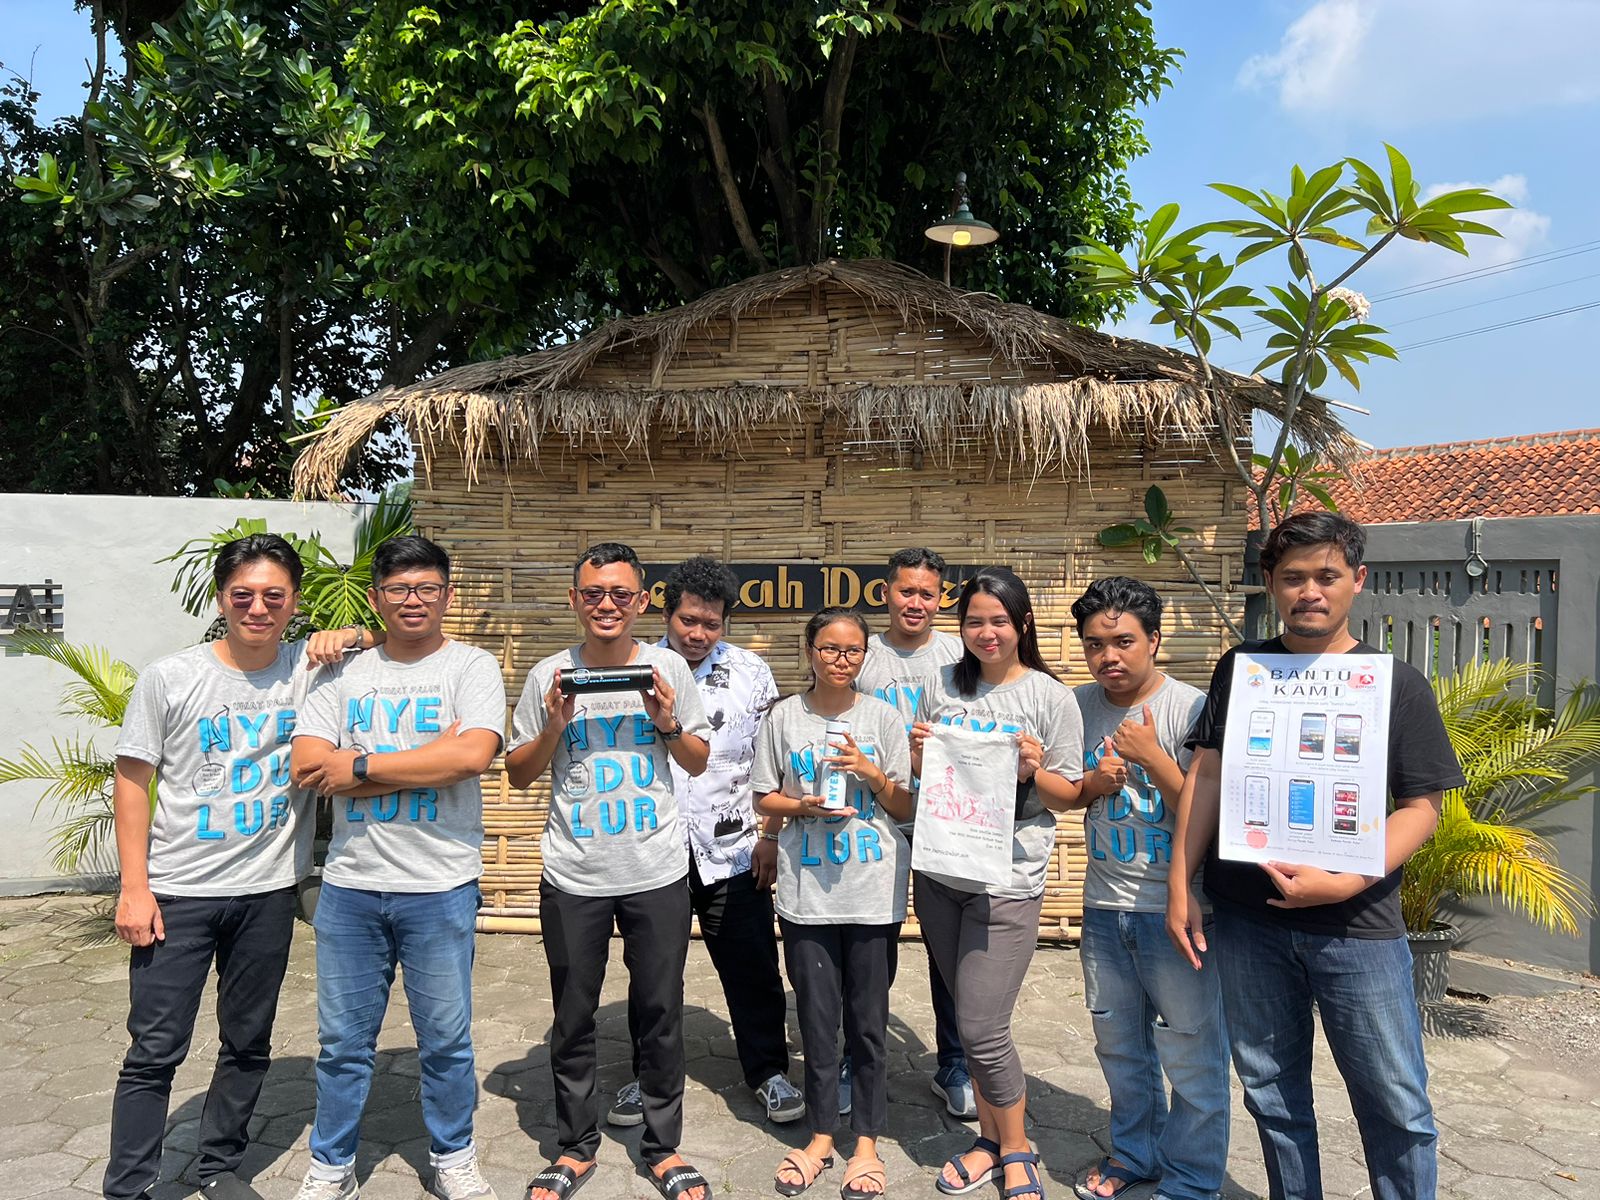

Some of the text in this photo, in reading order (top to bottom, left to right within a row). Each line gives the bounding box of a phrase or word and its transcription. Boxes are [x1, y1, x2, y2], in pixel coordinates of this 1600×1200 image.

[1270, 669, 1352, 681] BANTU
[1273, 684, 1340, 697] KAMI
[197, 708, 298, 753] NYE
[346, 696, 442, 734] NYE
[565, 710, 657, 751] NYE
[231, 751, 291, 794] DU
[593, 753, 655, 794] DU
[196, 794, 290, 840] LUR
[345, 786, 438, 823] LUR
[571, 795, 658, 838] LUR
[800, 827, 883, 866] LUR
[1090, 825, 1173, 864] LUR
